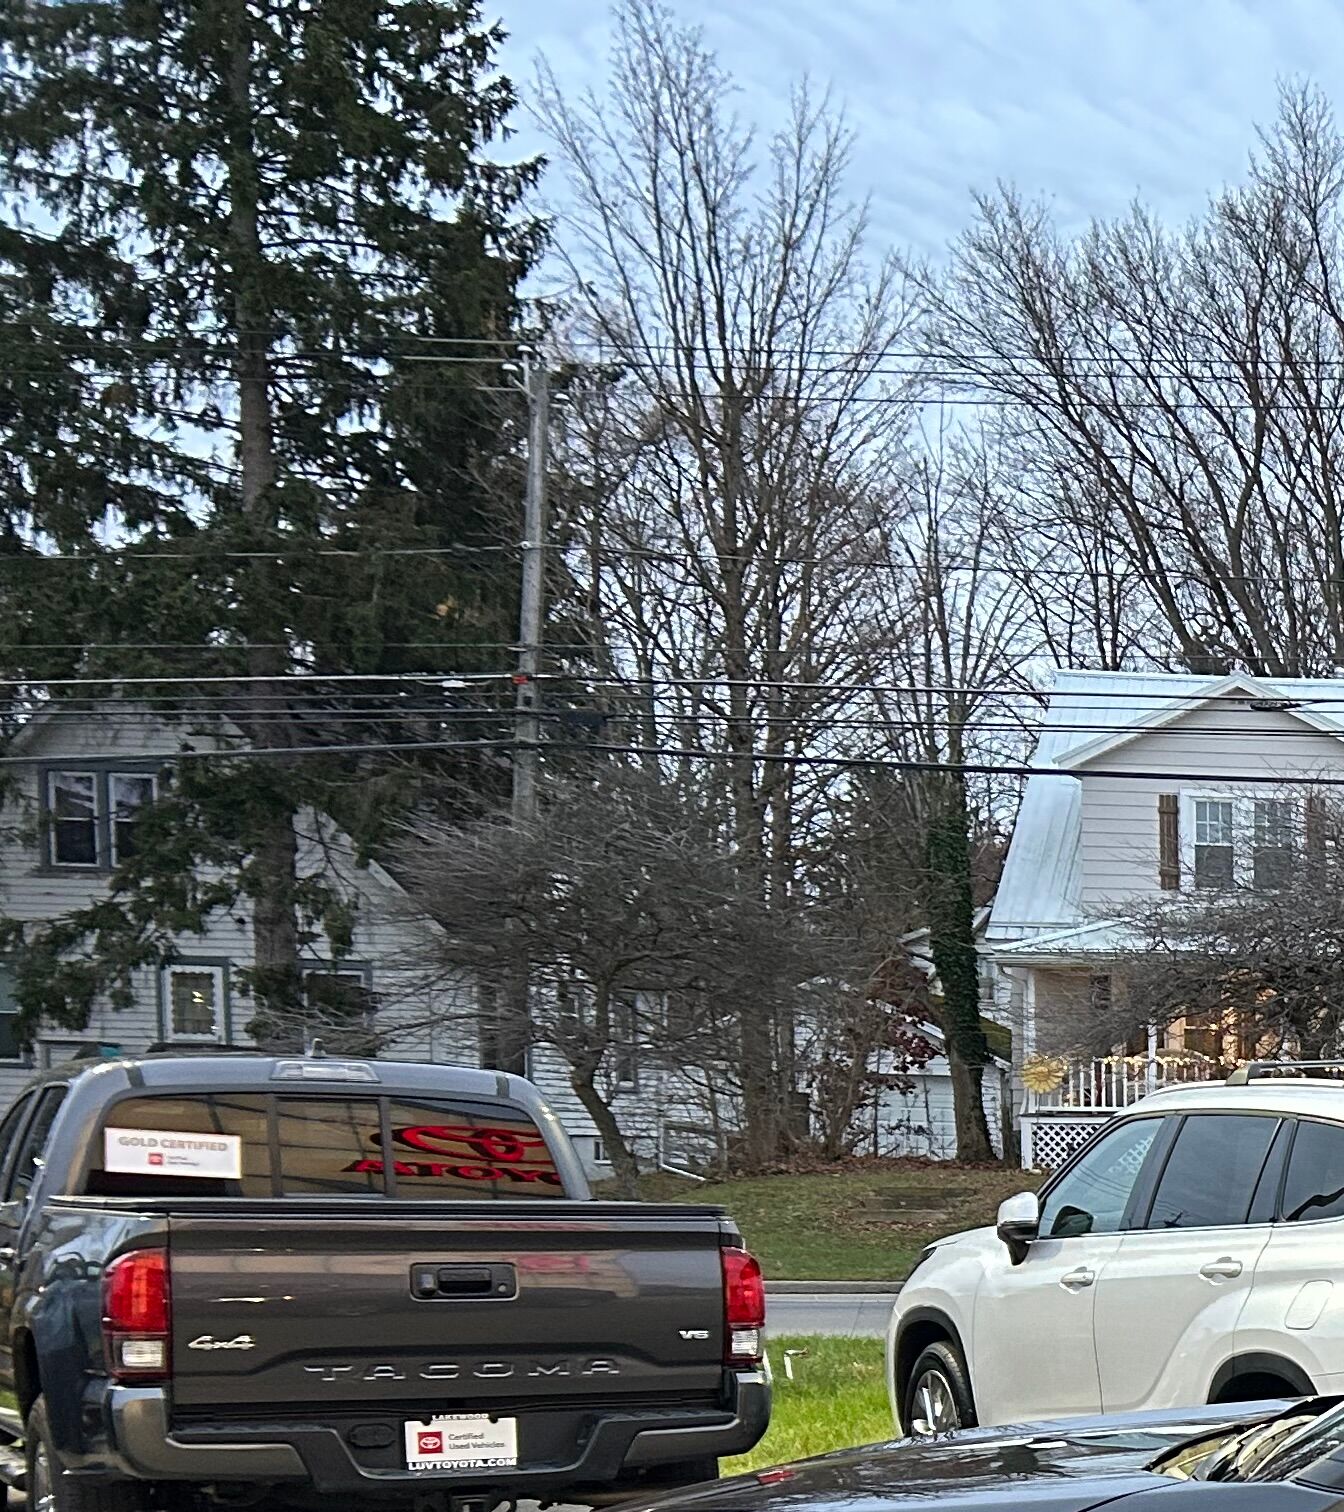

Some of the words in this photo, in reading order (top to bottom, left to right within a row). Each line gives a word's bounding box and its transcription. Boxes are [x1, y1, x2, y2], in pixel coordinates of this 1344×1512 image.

[118, 1136, 158, 1148] GOLD
[160, 1138, 228, 1152] CERTIFIED
[304, 1358, 620, 1382] TACOMA
[432, 1413, 490, 1421] LAKEWOOD
[448, 1432, 485, 1441] Certified
[449, 1442, 470, 1450] Used
[472, 1441, 505, 1449] Vehicles
[408, 1458, 517, 1471] LUVTOYOTA.COM
